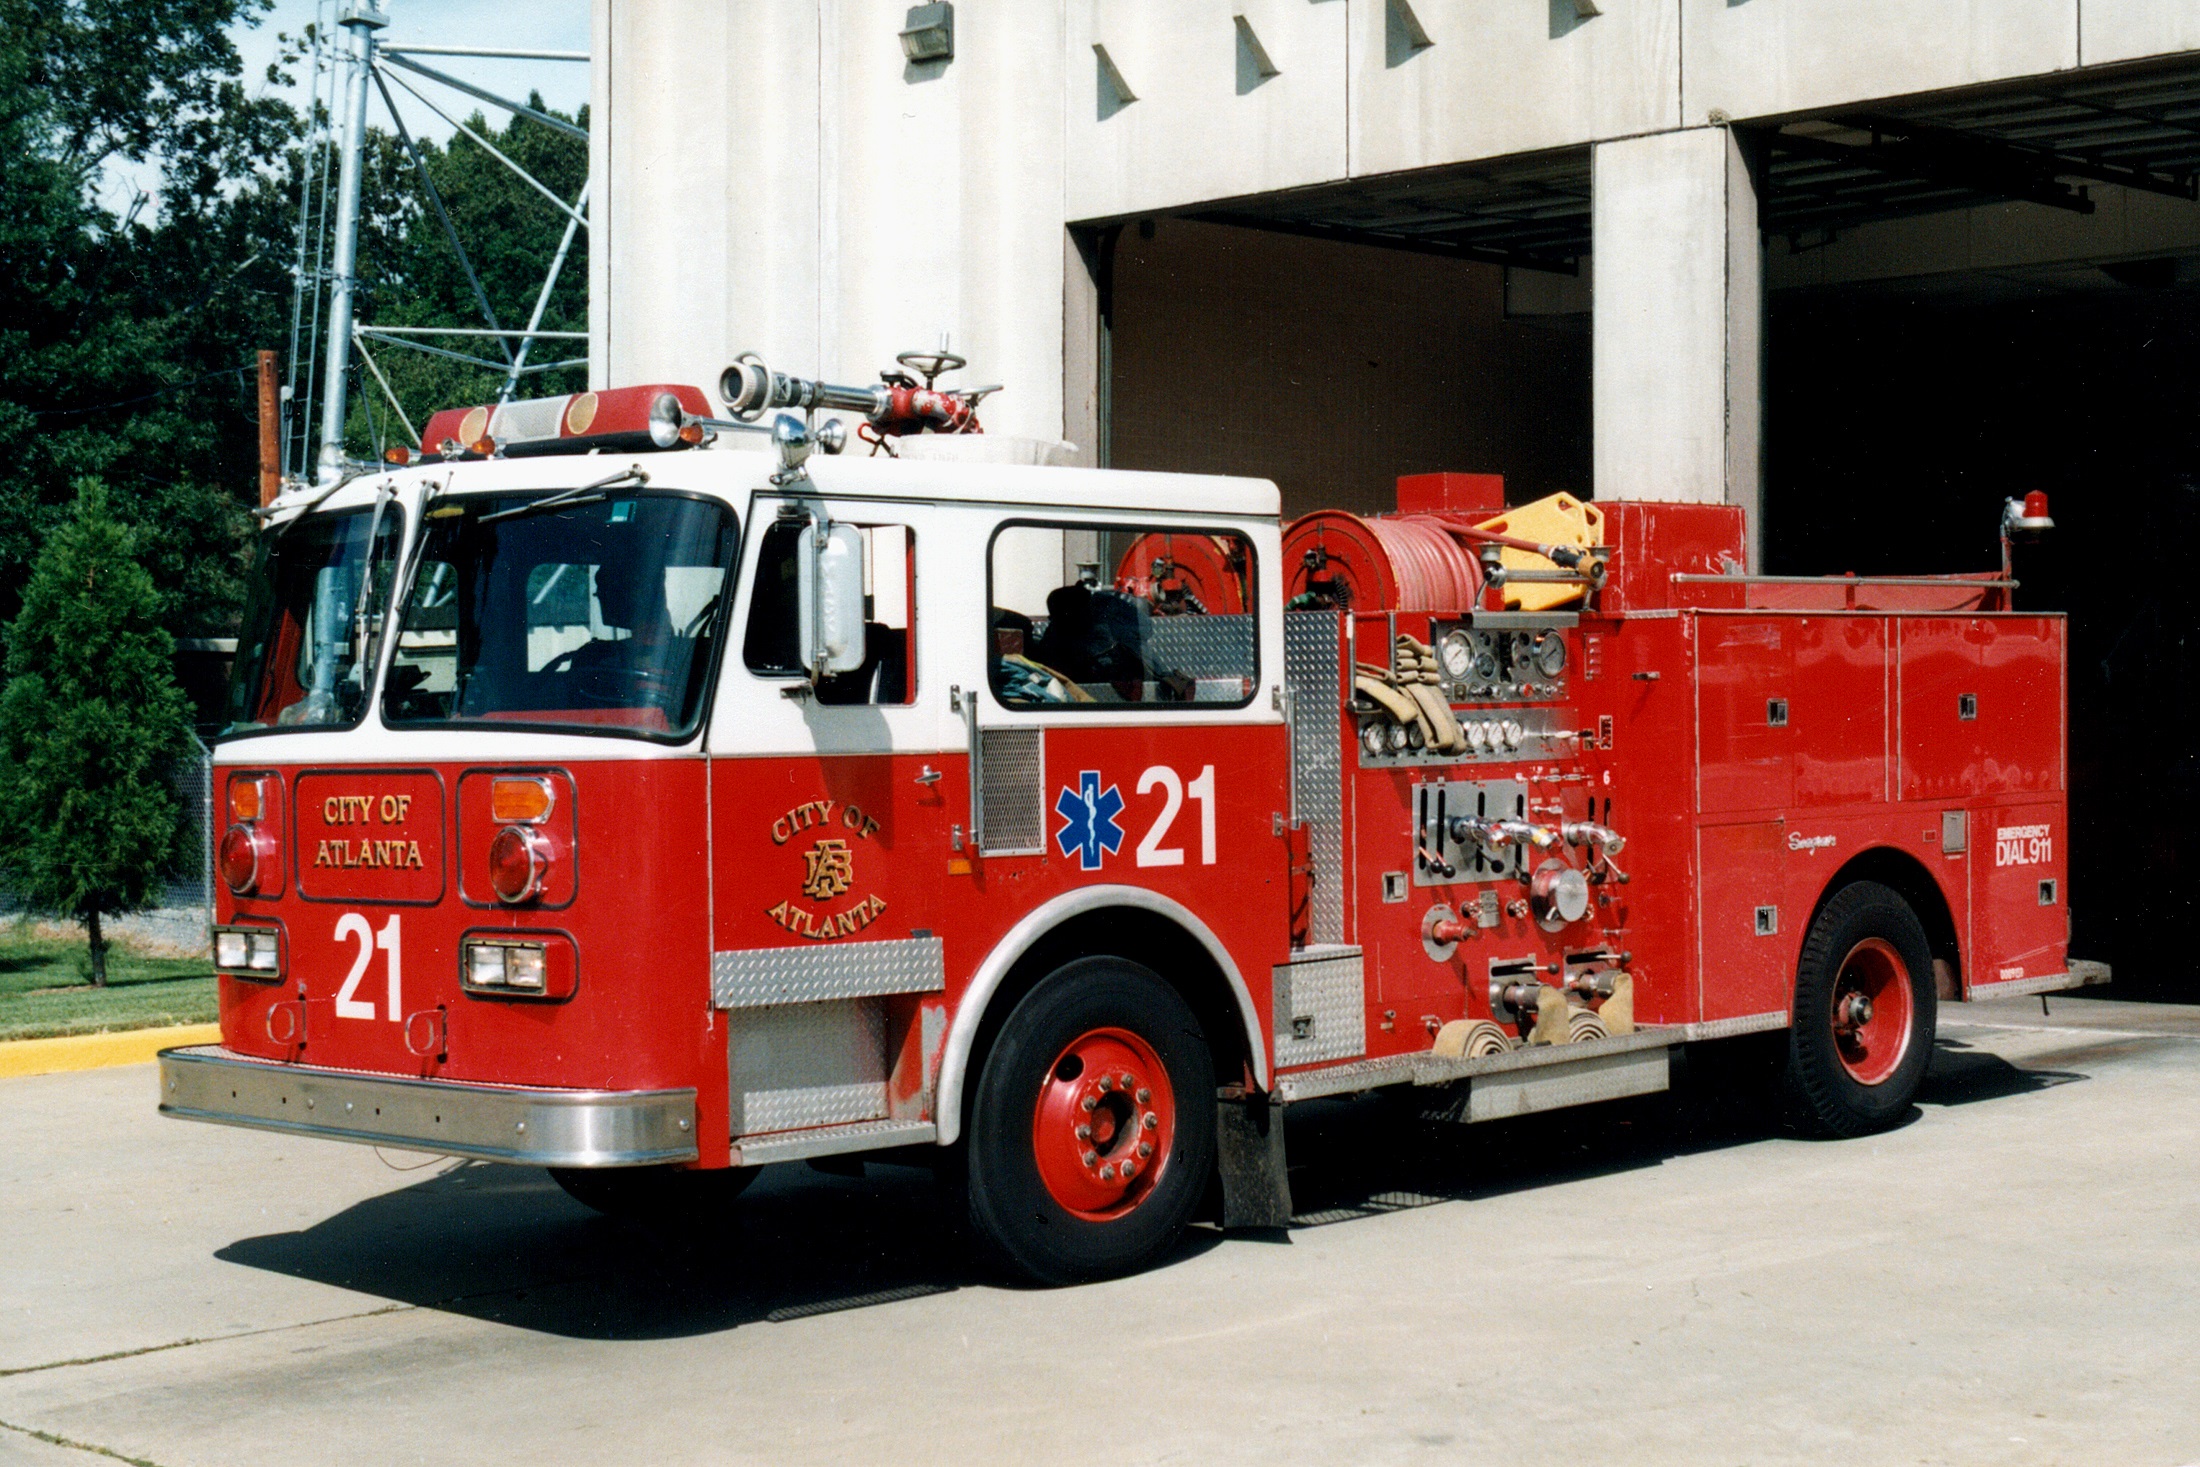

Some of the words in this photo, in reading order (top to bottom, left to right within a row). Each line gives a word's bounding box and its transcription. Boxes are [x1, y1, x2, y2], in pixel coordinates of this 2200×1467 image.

[1602, 769, 1611, 786] 6
[323, 795, 375, 826] CITY
[380, 794, 412, 825] OF
[771, 799, 836, 846] CITY
[842, 804, 881, 839] OF
[1136, 764, 1217, 869] 21
[1996, 823, 2051, 841] EMERGENCY
[313, 838, 424, 870] ATLANTA
[1996, 839, 2029, 867] DIAL
[2029, 837, 2052, 864] 911
[764, 893, 887, 940] ATLANTA
[333, 912, 402, 1023] 21
